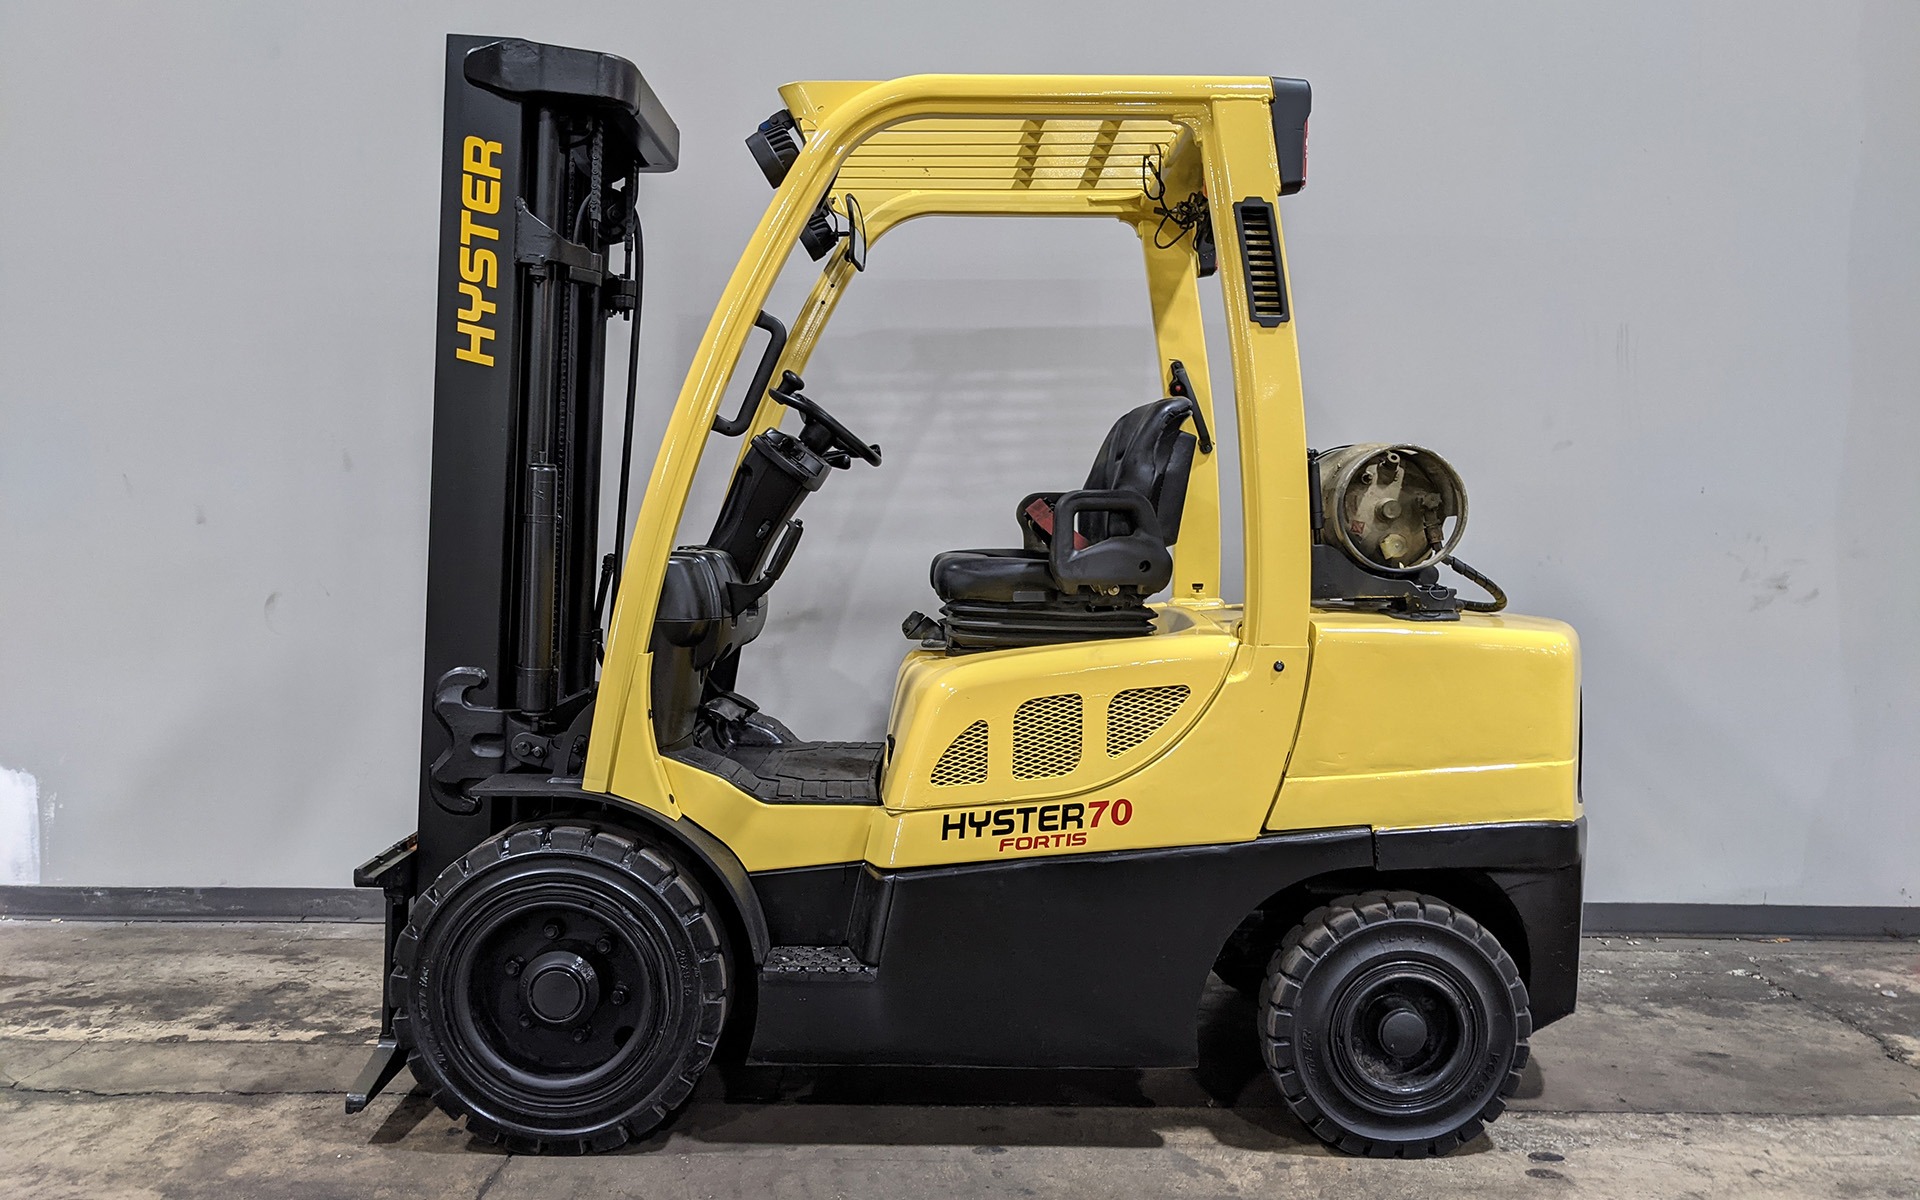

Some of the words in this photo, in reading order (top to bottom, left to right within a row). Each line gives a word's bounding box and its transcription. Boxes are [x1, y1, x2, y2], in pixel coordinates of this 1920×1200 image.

[455, 135, 503, 368] HYSTER
[941, 803, 1085, 841] HYSTER
[998, 832, 1088, 852] FORTIS
